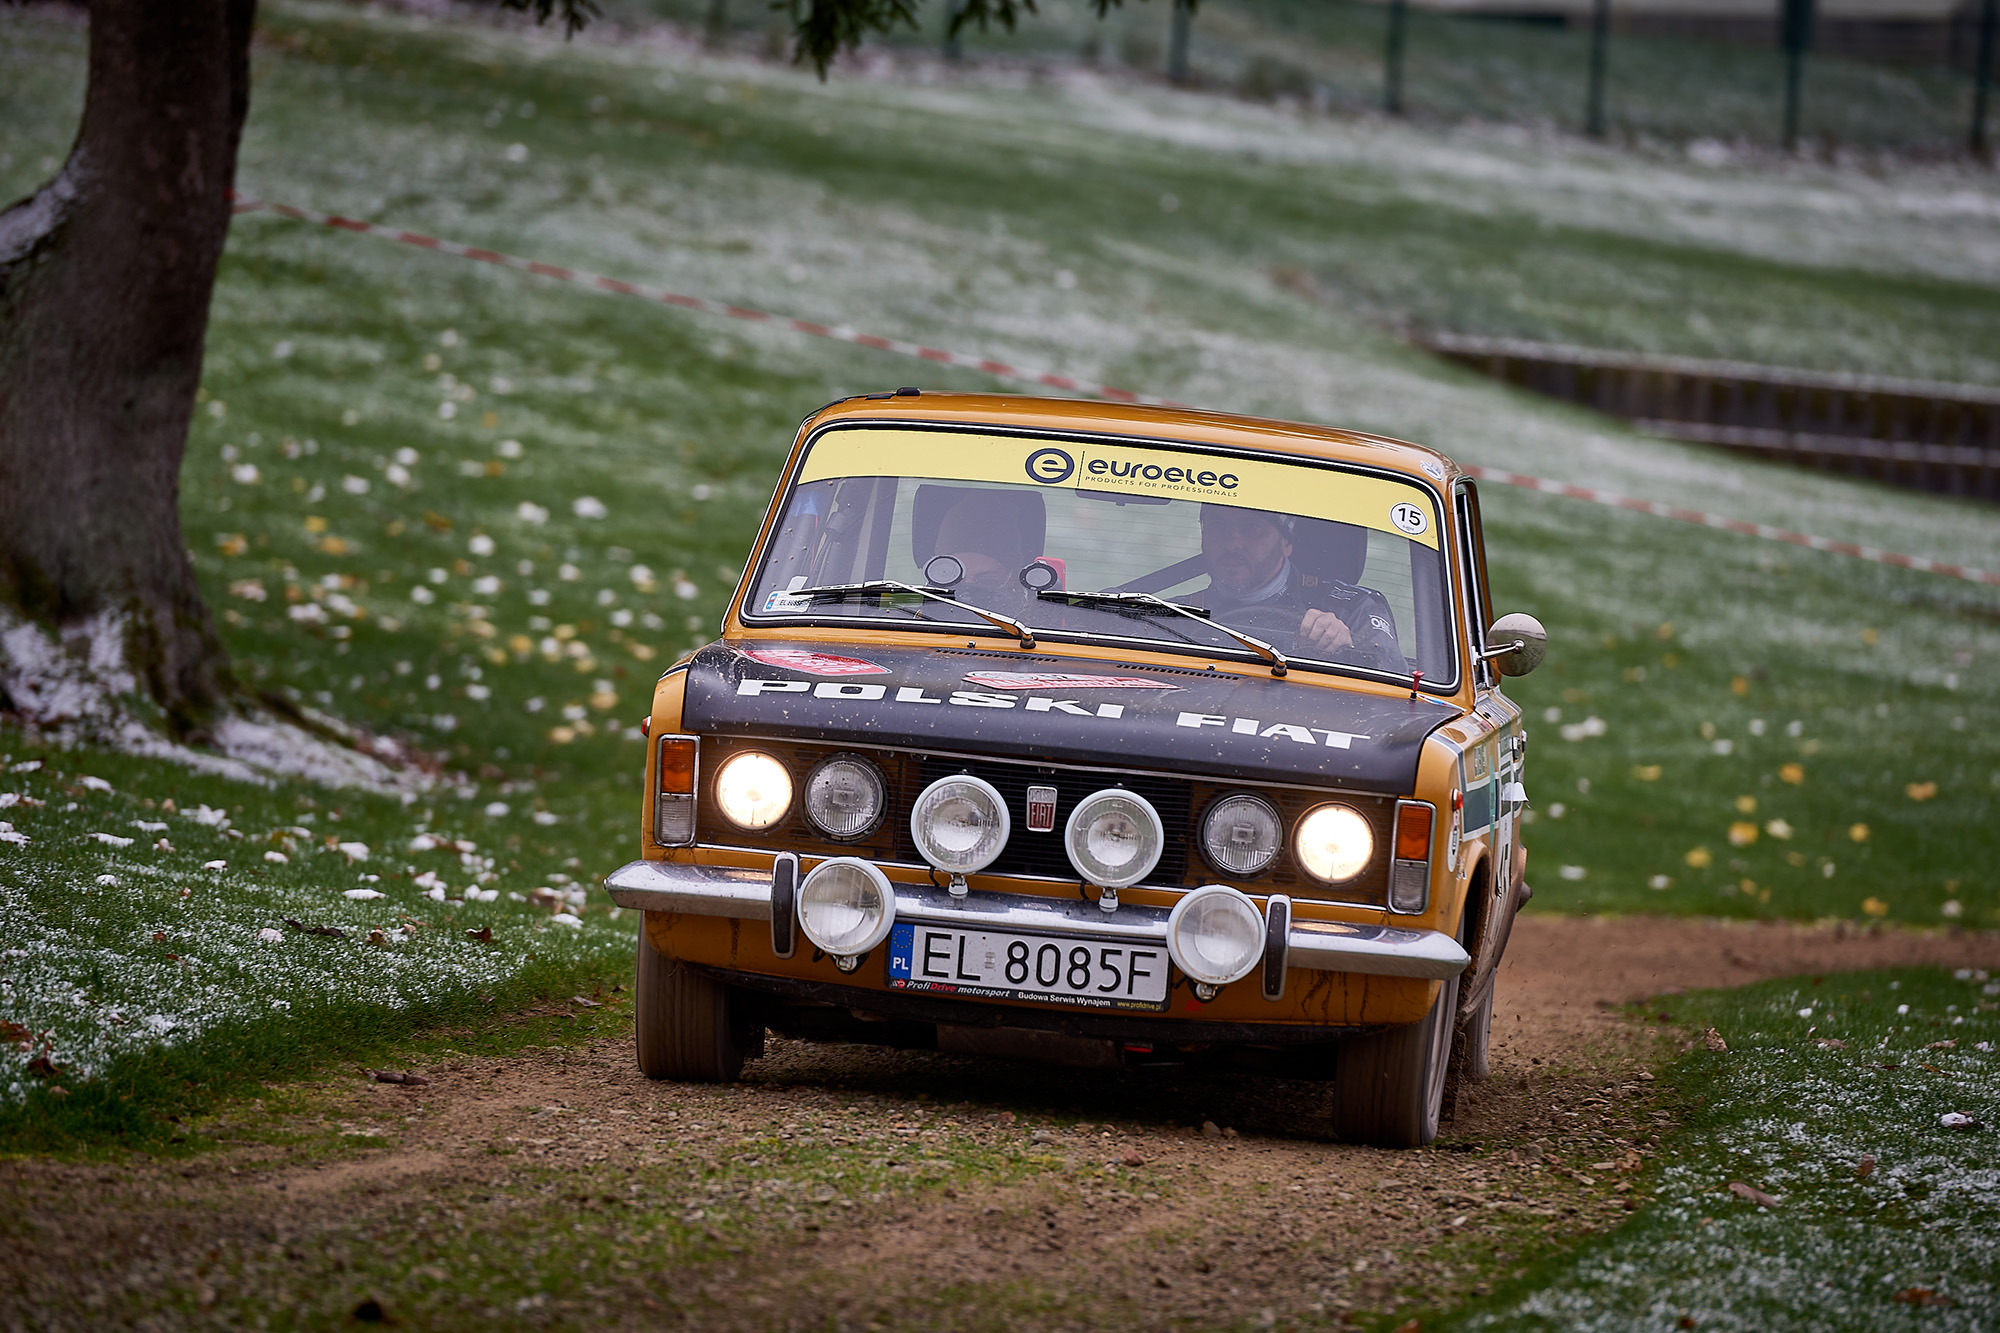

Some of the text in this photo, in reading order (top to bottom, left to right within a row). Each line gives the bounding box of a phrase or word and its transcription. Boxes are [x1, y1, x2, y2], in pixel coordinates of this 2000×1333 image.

[1085, 475, 1135, 486] PRODUCTS
[1161, 484, 1239, 498] PROFESSIONALS
[1087, 459, 1240, 490] euroelec
[1398, 507, 1421, 526] 15
[736, 679, 1125, 719] POLSKI
[1176, 711, 1372, 750] FIAT
[1031, 802, 1053, 827] FIAT
[892, 957, 909, 971] PL
[922, 931, 1158, 995] EL 8085F
[906, 980, 957, 993] ProfiDrive
[957, 986, 1011, 998] motorsport
[1017, 991, 1049, 1002] Budowa
[1049, 994, 1076, 1004] Serwis
[1076, 996, 1111, 1007] Wynajem
